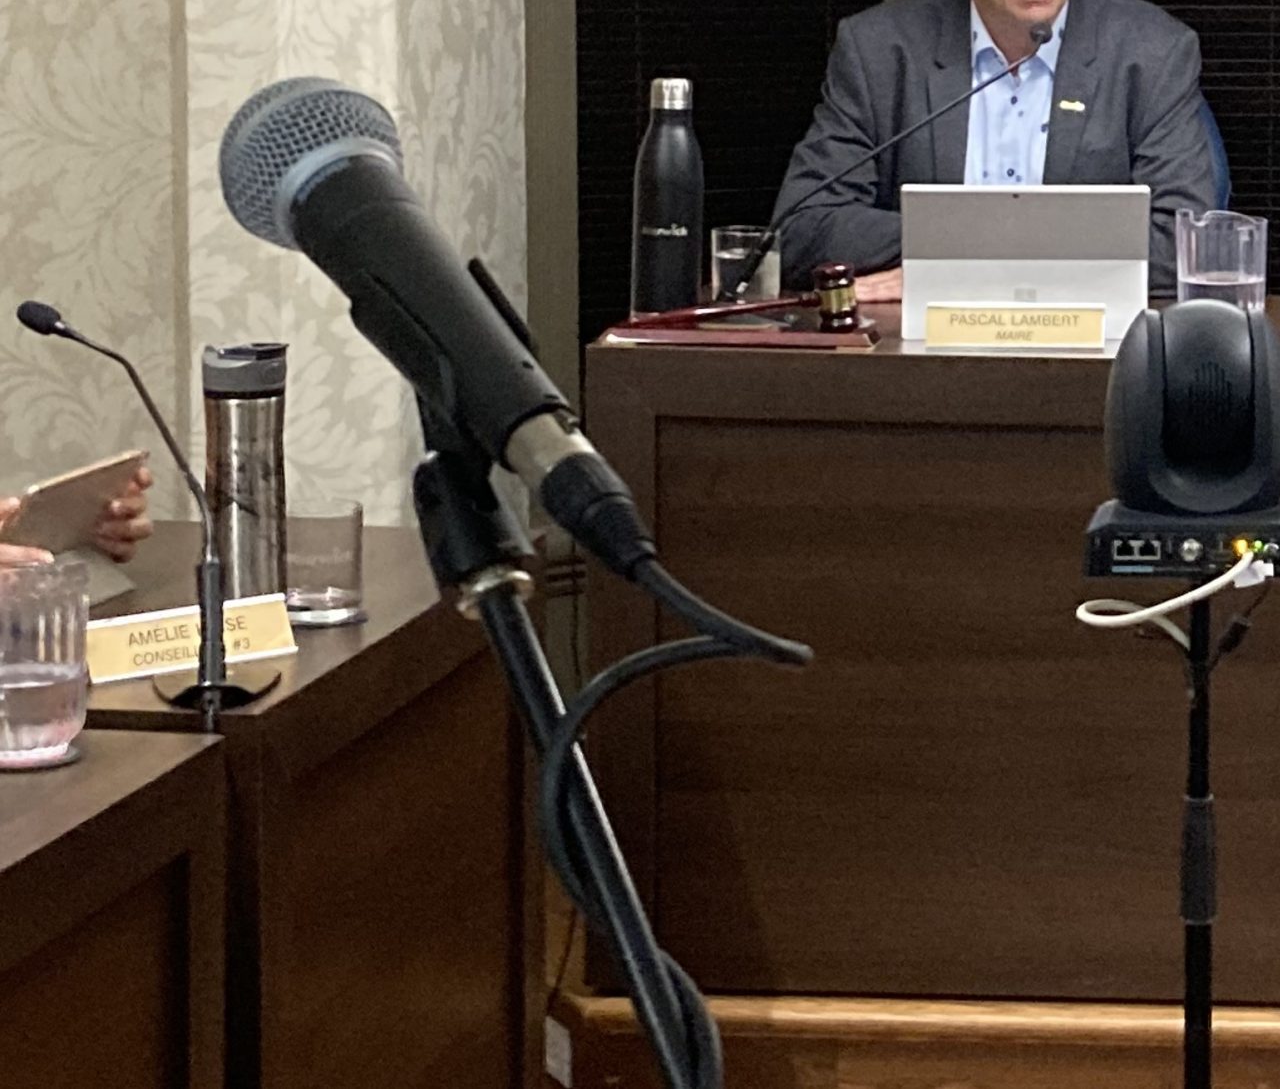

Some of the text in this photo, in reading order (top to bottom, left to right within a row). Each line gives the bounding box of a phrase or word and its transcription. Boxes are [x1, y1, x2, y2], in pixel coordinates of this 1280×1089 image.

[949, 313, 1080, 327] PASCAL LAMBERT
[995, 329, 1034, 342] MAIRE
[132, 638, 251, 667] CONSEILL #3
